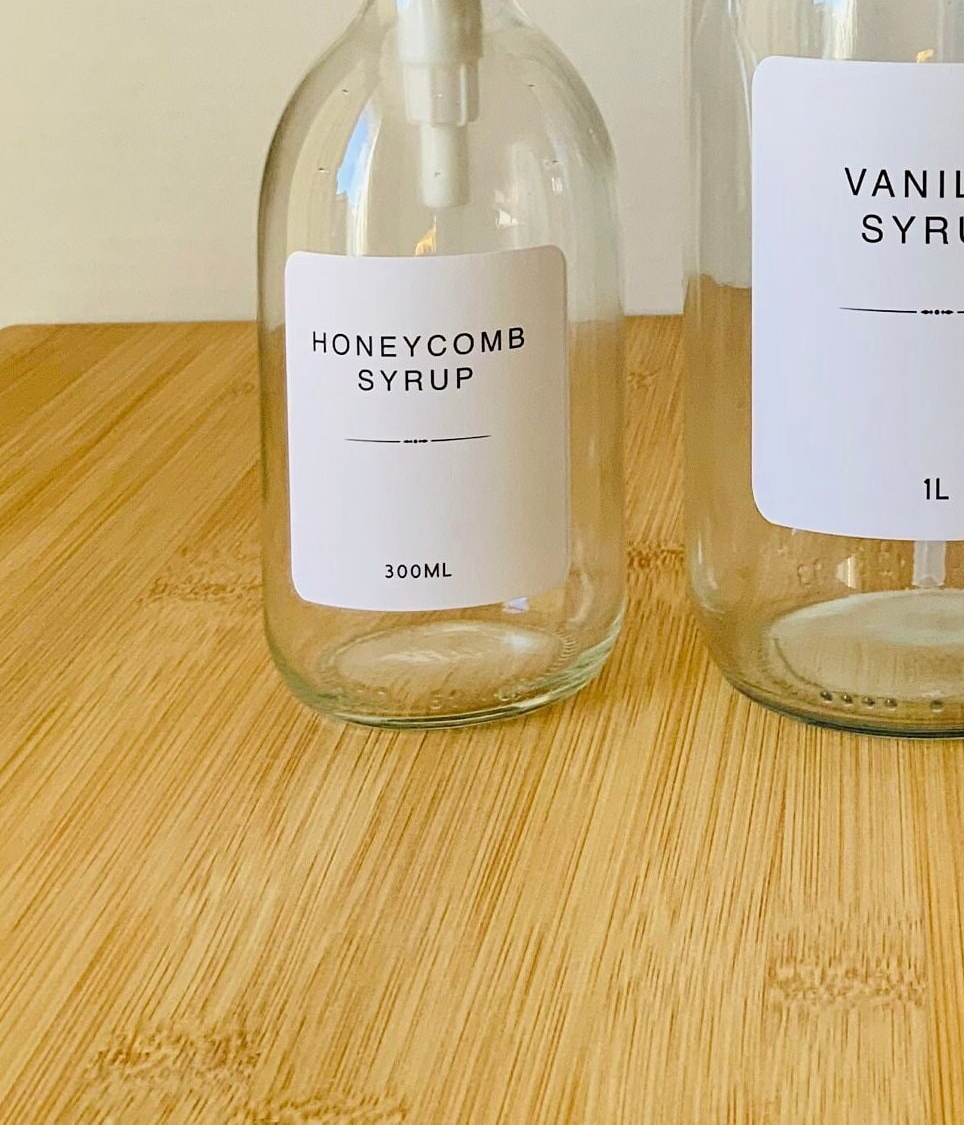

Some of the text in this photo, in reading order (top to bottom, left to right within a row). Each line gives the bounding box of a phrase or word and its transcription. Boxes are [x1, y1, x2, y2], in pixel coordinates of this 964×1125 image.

[312, 326, 525, 357] HONEYCOMB
[357, 366, 473, 391] SYRUP
[923, 477, 949, 500] 1L
[384, 562, 452, 578] 300ML
